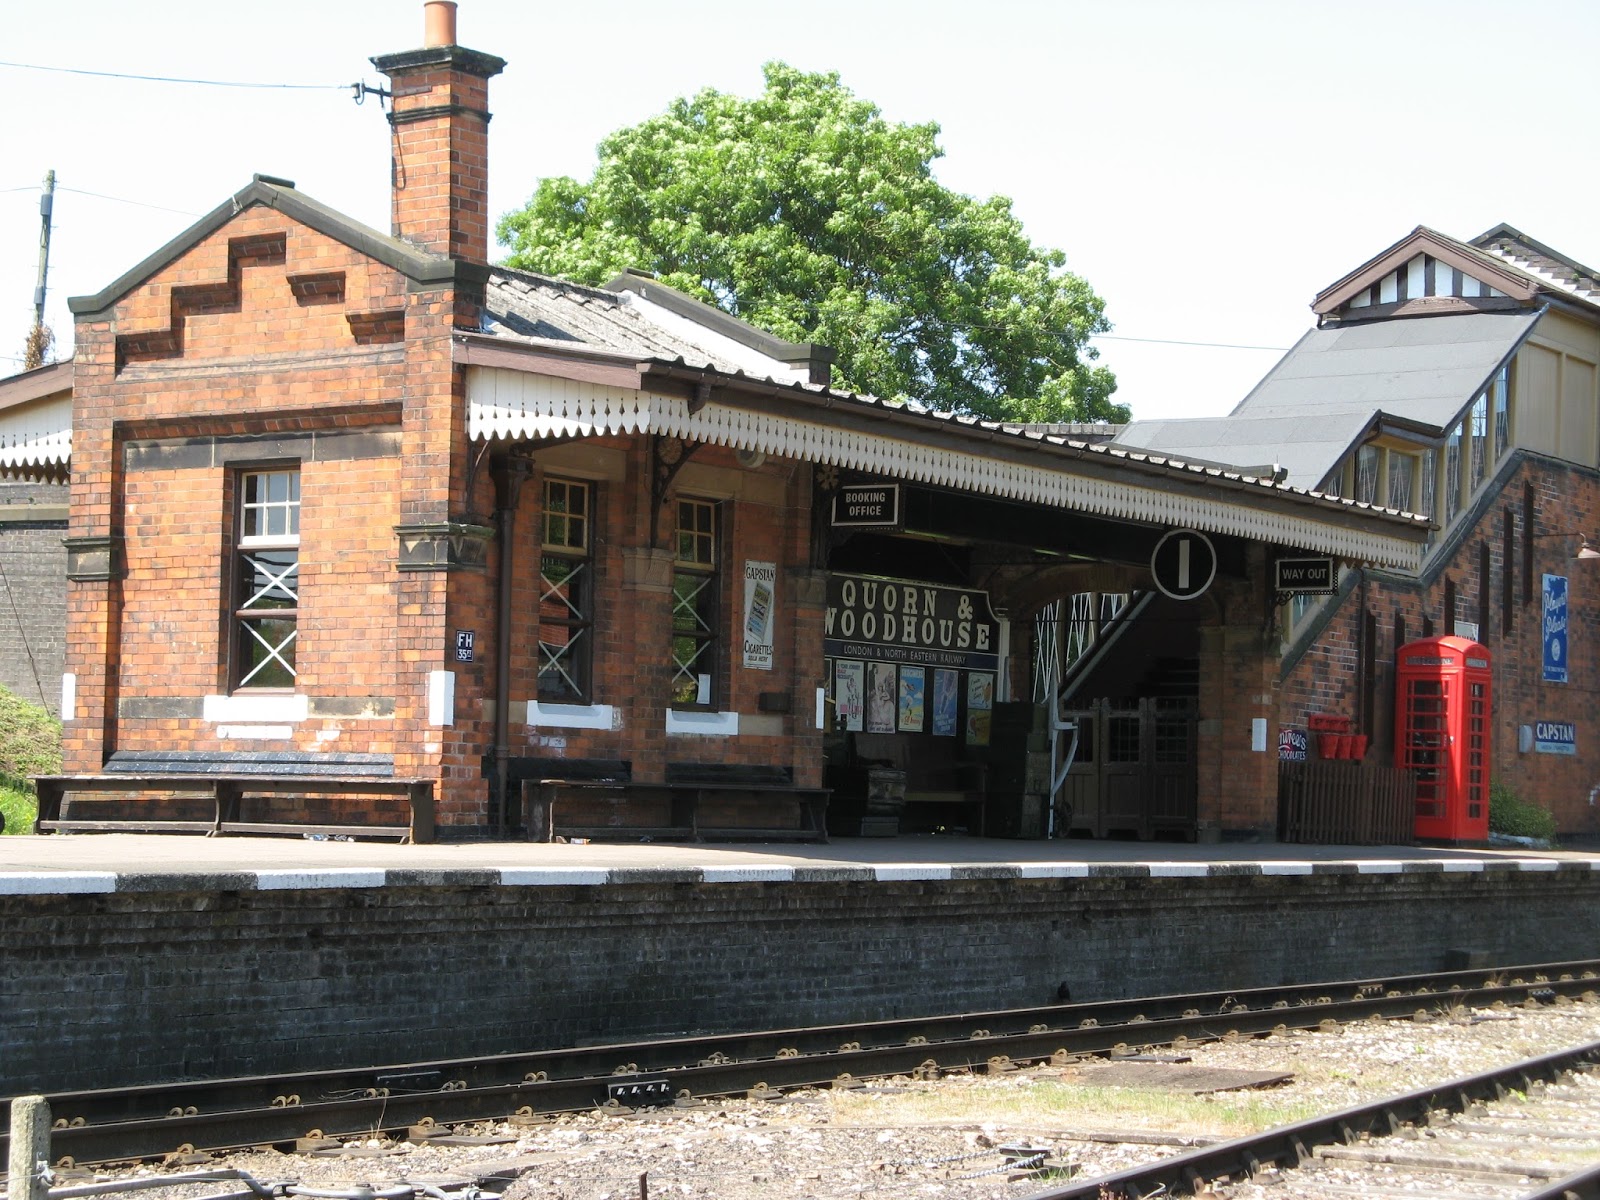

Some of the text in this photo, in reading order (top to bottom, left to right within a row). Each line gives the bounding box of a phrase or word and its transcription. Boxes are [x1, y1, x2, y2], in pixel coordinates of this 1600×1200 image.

[845, 492, 885, 503] BOOKING
[849, 505, 882, 517] OFFICE
[746, 567, 774, 581] CAPSTAN
[1282, 567, 1327, 580] WAY OUT
[842, 579, 974, 621] QUORN &
[825, 608, 989, 650] WOODHOUSE
[458, 633, 472, 647] FH
[745, 640, 772, 655] CIGARETTES
[843, 645, 967, 664] LONDON & NORTH EASTERN RAILWAY
[1536, 722, 1574, 741] CAPSTAN
